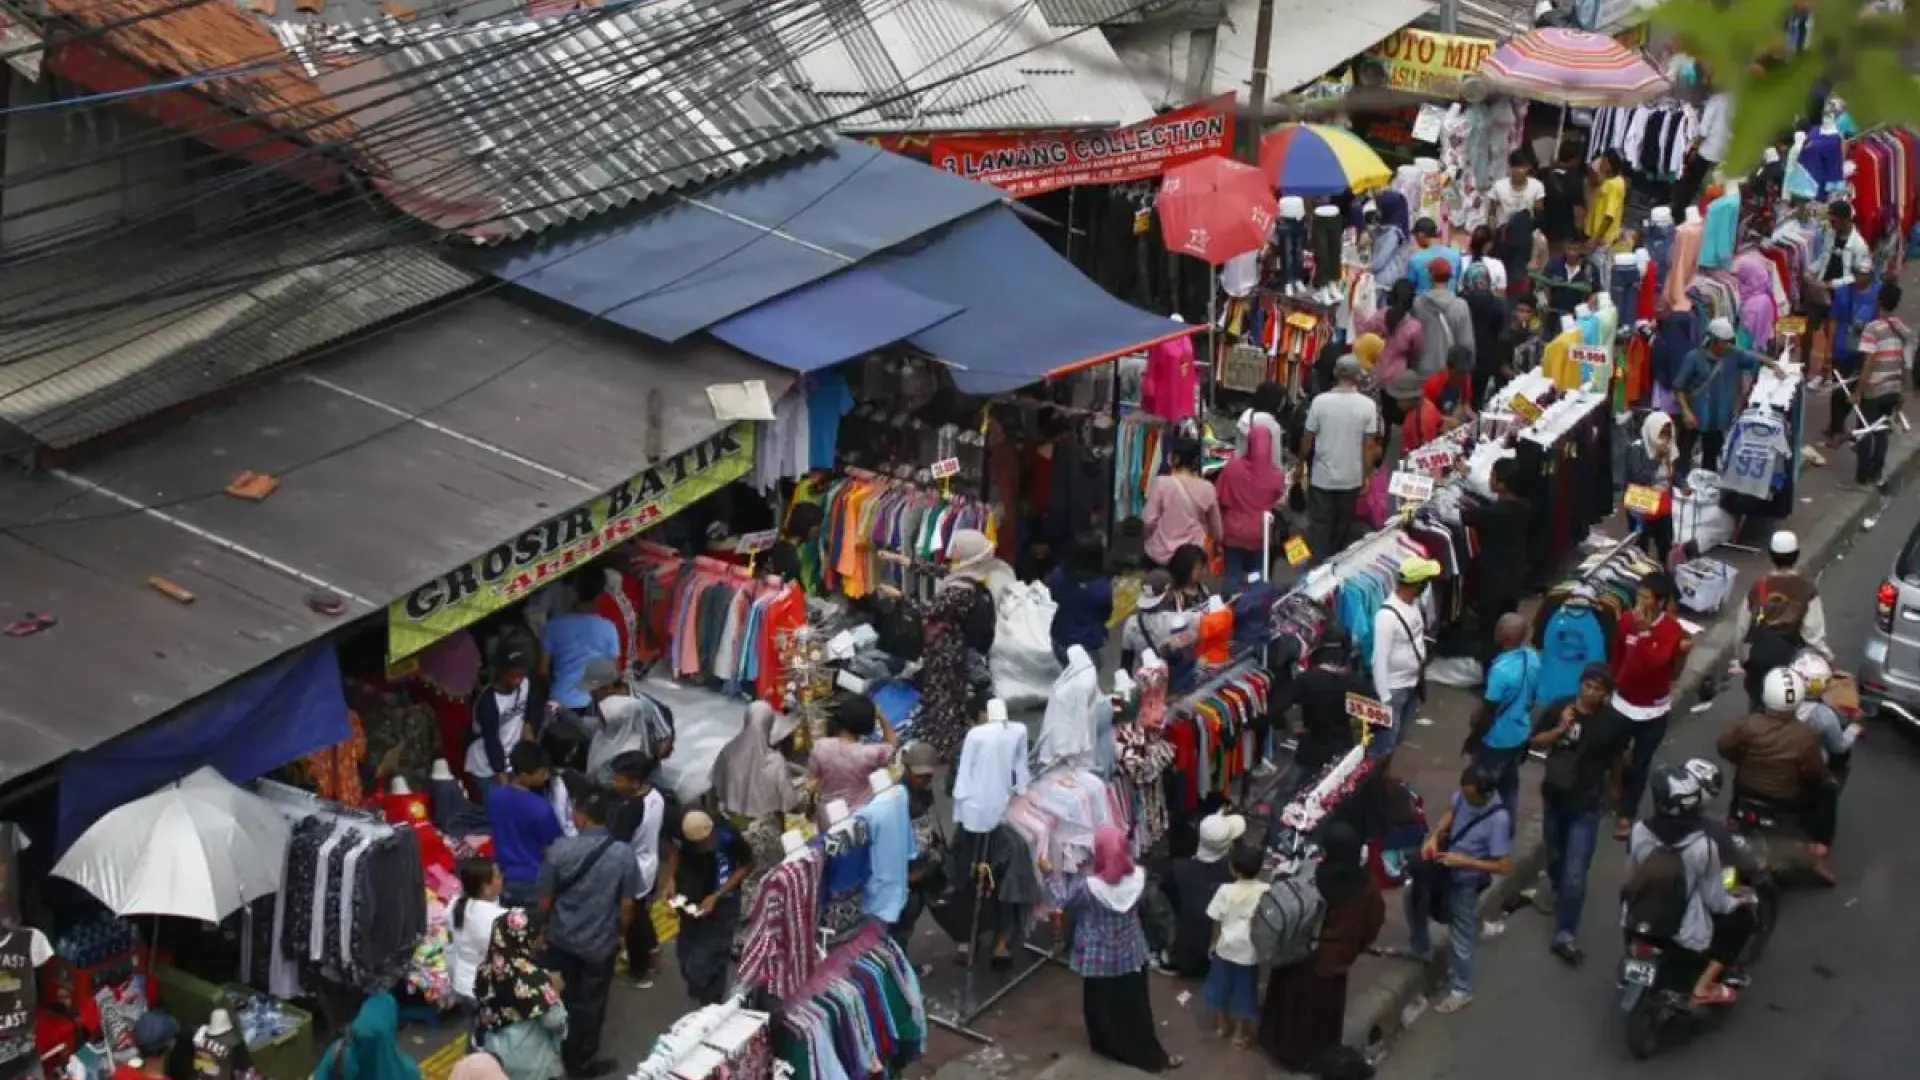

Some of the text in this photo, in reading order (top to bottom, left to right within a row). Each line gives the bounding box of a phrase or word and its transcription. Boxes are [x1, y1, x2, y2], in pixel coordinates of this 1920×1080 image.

[1371, 32, 1435, 63] OTO
[964, 142, 1068, 178] LANANG
[1071, 115, 1225, 160] COLLECTION
[404, 428, 742, 620] GROSIR BATIK
